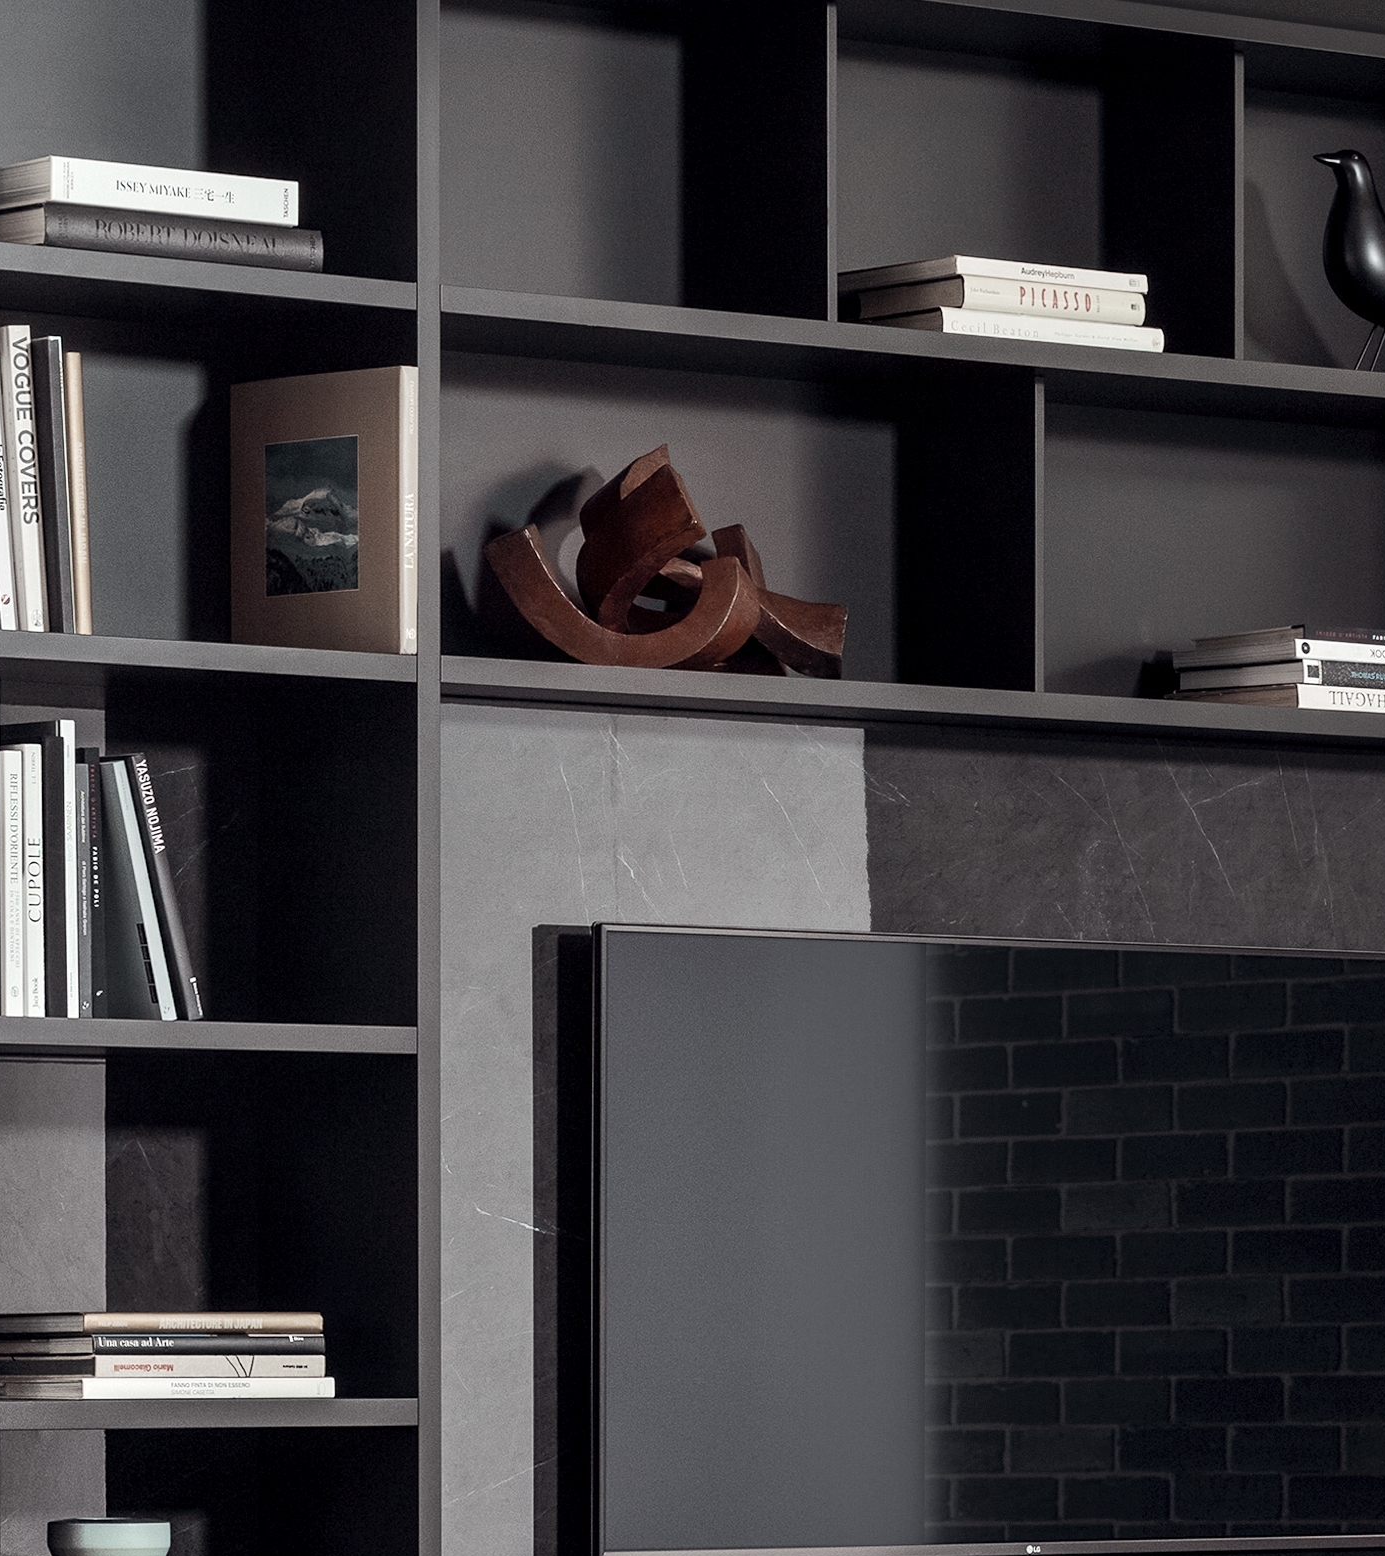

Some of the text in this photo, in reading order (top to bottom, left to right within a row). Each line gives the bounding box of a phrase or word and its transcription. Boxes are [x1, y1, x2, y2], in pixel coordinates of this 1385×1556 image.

[116, 178, 236, 205] ISSEY MIYAKE 三宅一生
[282, 187, 290, 219] TASCHEN
[94, 218, 176, 246] ROBERT
[182, 227, 285, 257] DOISNEAU
[1020, 266, 1076, 281] AudreyHepburn
[1019, 285, 1092, 314] PICASSO
[950, 319, 1040, 339] Cecil Beaton
[11, 336, 40, 526] VOGUE COVERS
[78, 529, 88, 564] JAPAN
[403, 492, 415, 569] LA NATURA
[66, 800, 74, 843] SAARINEN
[134, 759, 166, 855] YASUZO NOJIMA
[9, 773, 20, 884] RIFLESSI D'ORIENTE
[27, 837, 42, 923] CUPOLE
[93, 874, 99, 885] DE
[159, 1317, 263, 1329] ARCHITECTURE IN JAPAN
[97, 1336, 175, 1349] Una casa ad Arte
[113, 1362, 174, 1373] Mario Giacomelli
